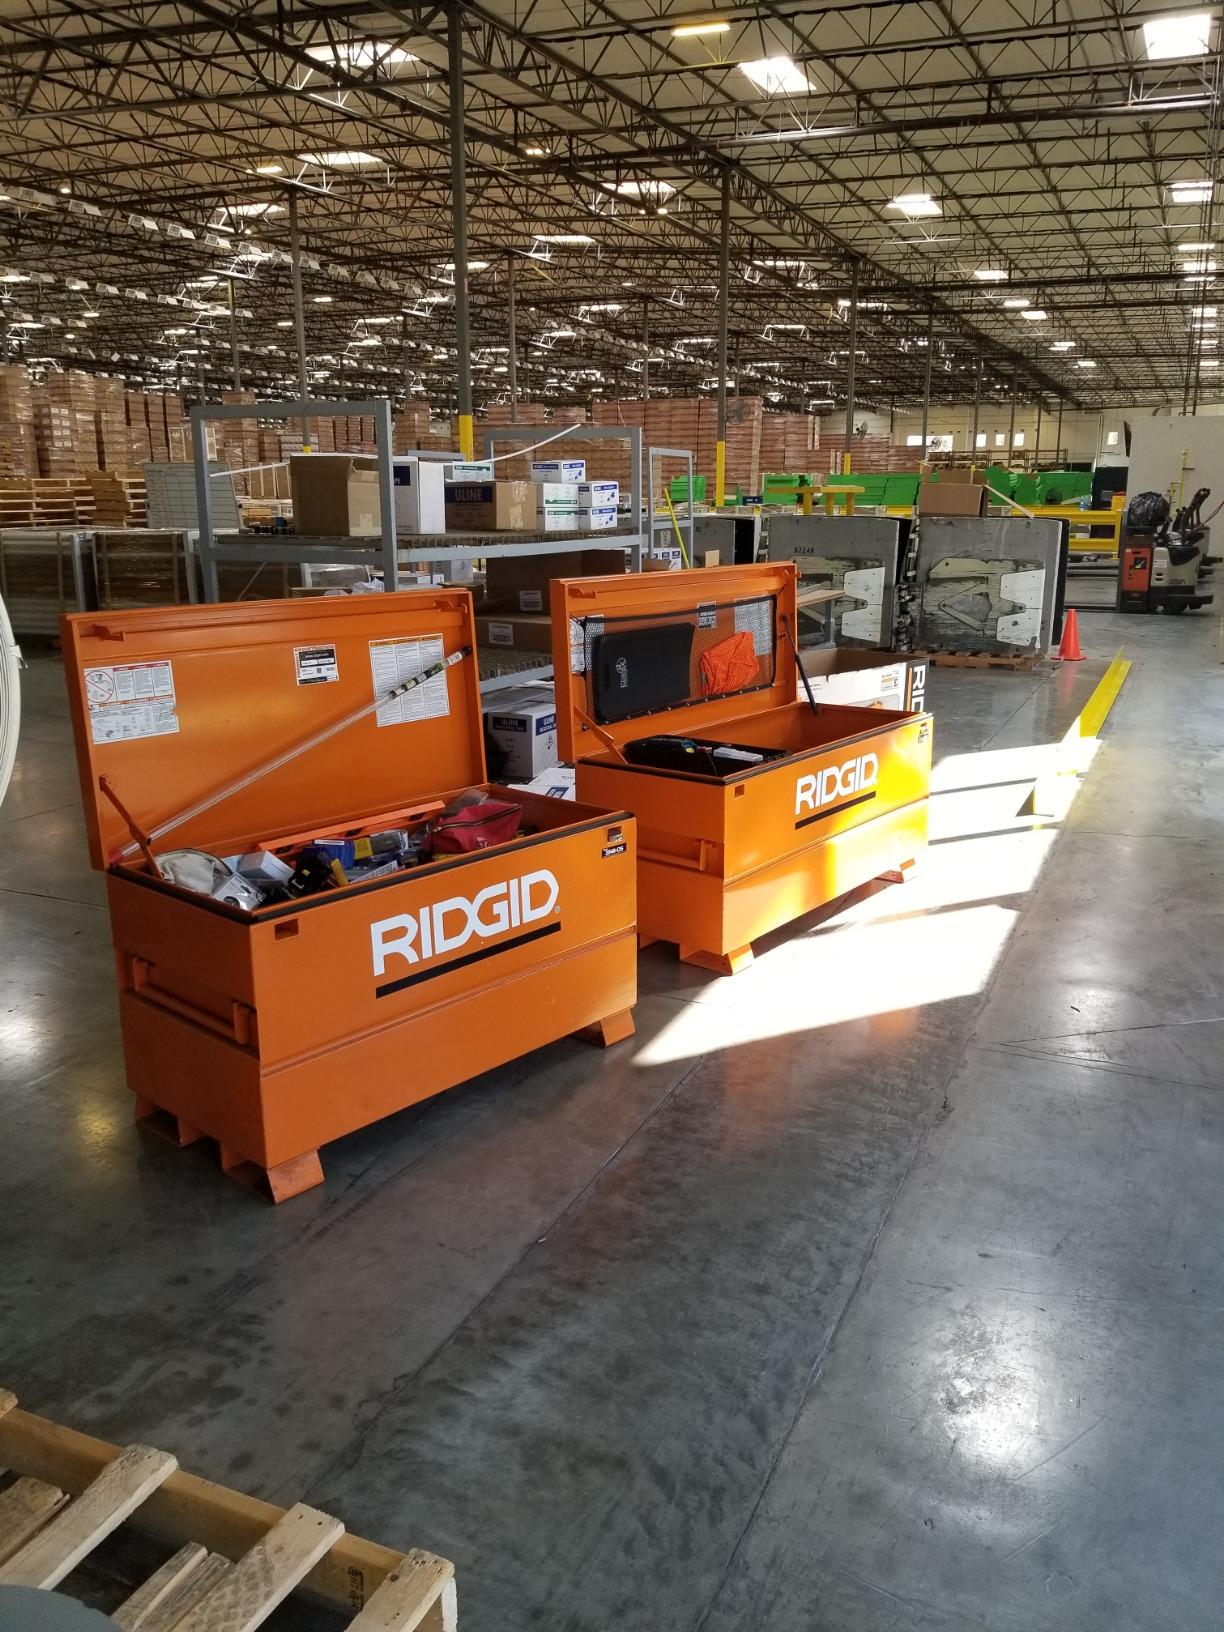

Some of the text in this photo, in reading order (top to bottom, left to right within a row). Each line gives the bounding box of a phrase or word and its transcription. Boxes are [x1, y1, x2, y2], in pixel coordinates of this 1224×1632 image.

[455, 488, 482, 501] ULINE
[912, 664, 925, 713] RID
[795, 752, 879, 815] RIDGID
[370, 869, 559, 977] RIDGID
